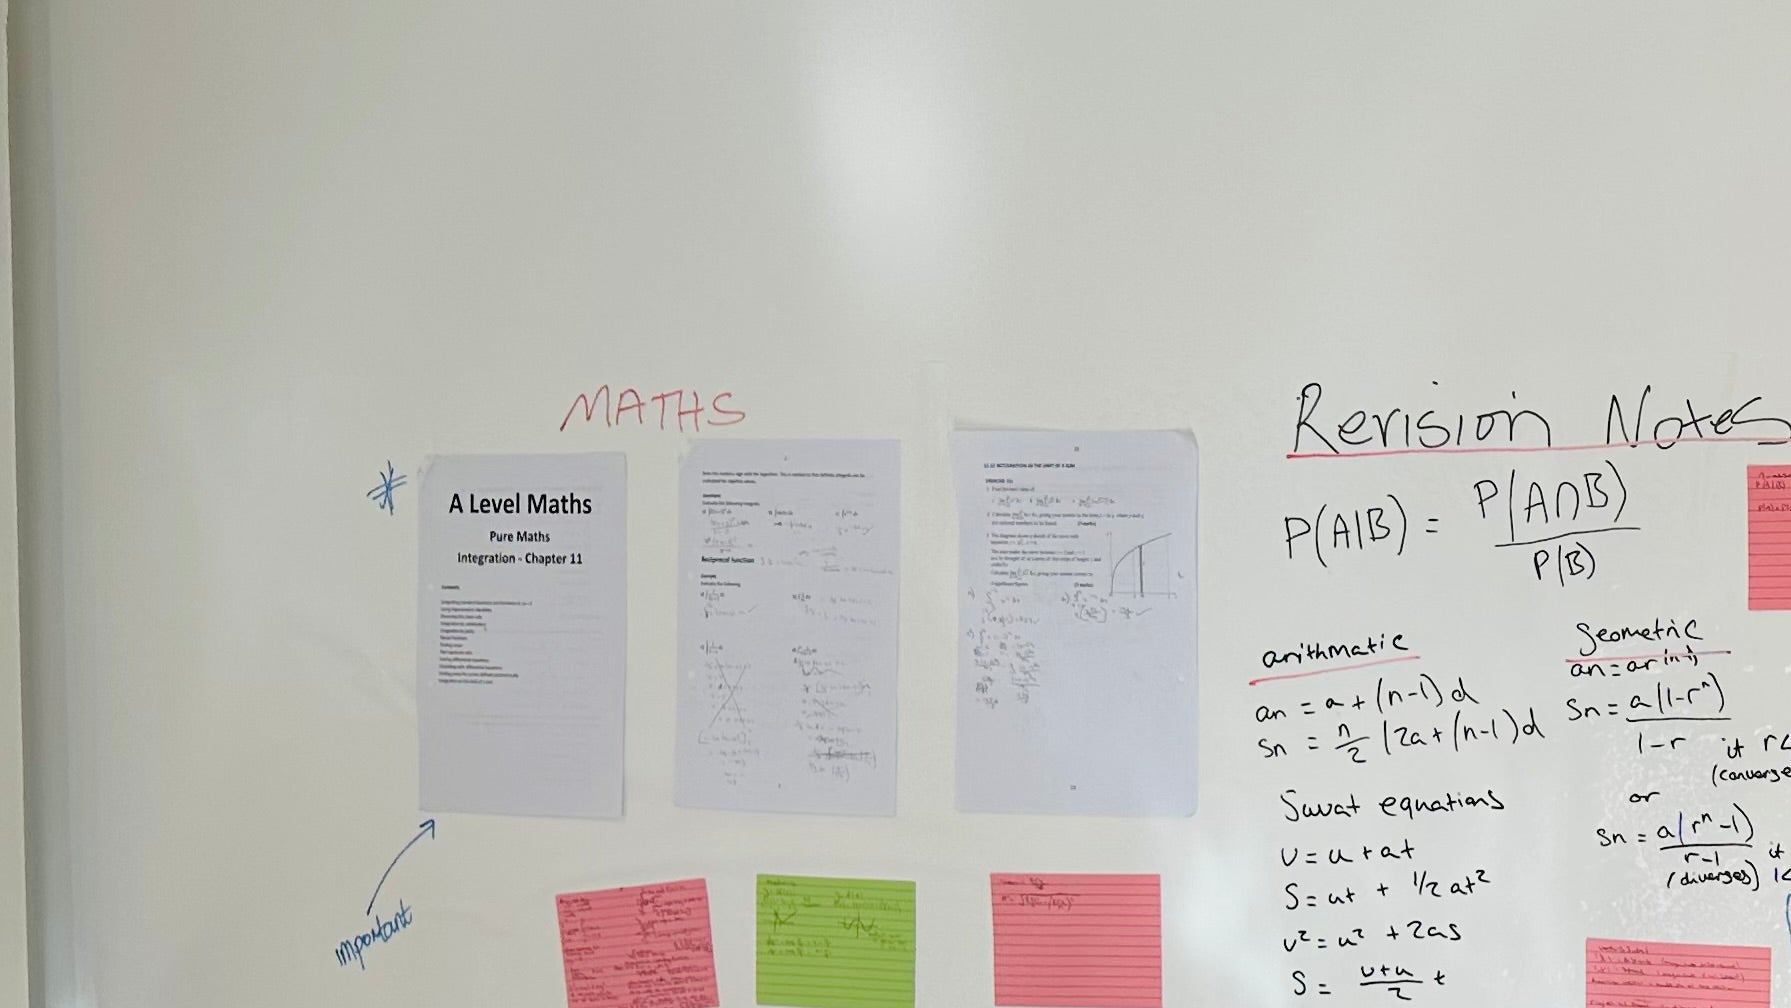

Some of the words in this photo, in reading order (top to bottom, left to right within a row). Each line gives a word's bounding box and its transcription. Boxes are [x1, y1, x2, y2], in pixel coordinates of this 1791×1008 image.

[560, 384, 746, 432] MATHS
[1293, 381, 1551, 455] Revision
[448, 493, 464, 514] A
[470, 492, 520, 514] Level
[527, 492, 592, 515] Maths
[489, 530, 514, 543] Pure
[516, 530, 551, 543] Maths
[457, 552, 516, 566] Integration
[524, 552, 567, 567] Chapter
[570, 553, 583, 565] 11
[1629, 791, 1661, 803] or
